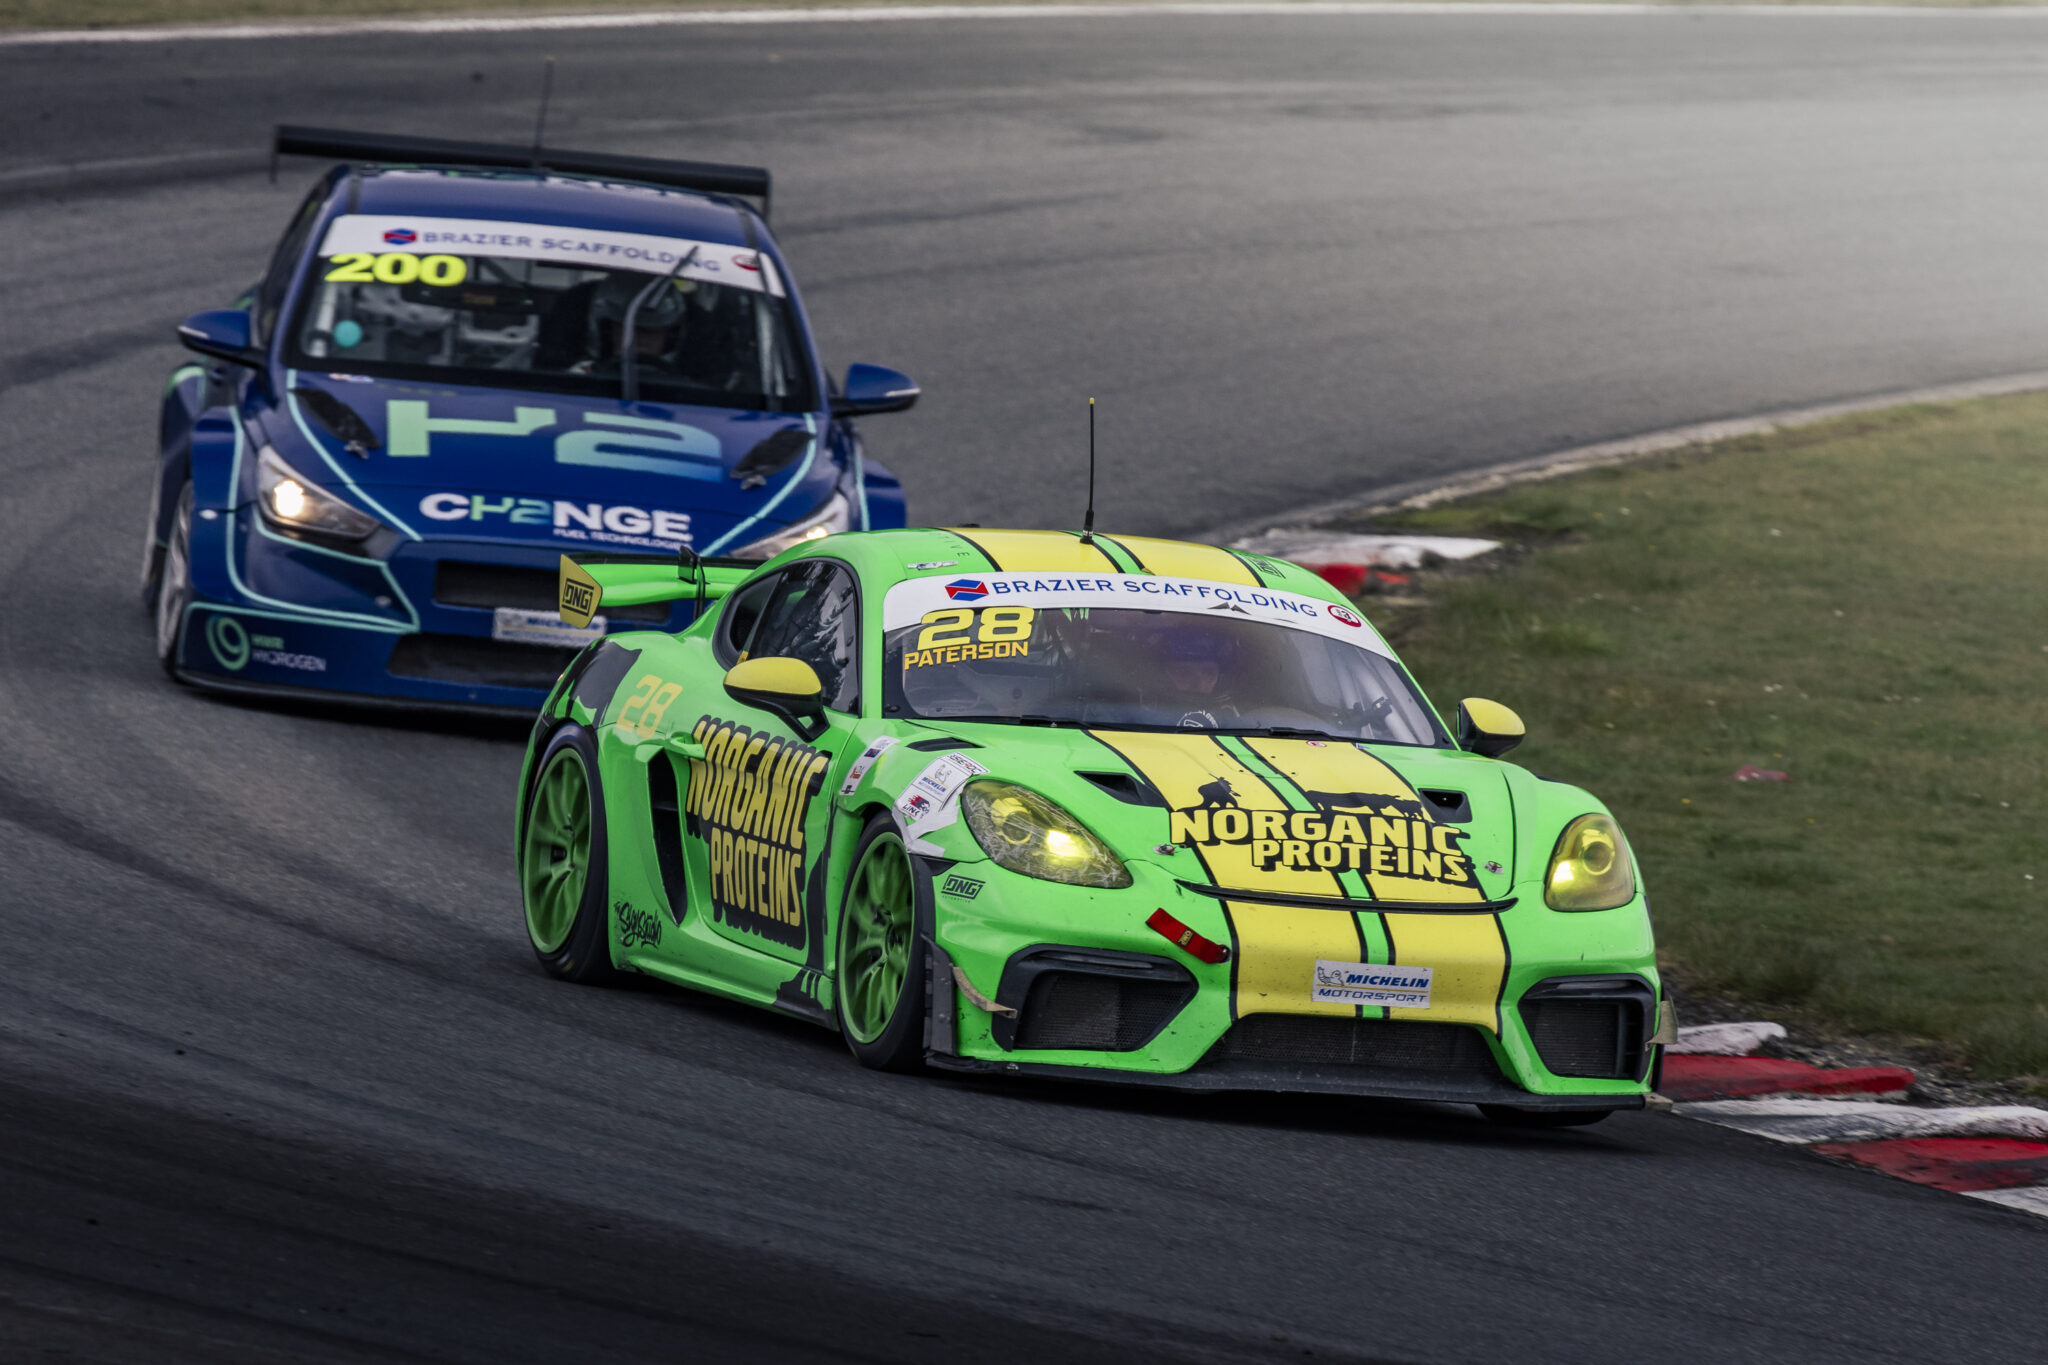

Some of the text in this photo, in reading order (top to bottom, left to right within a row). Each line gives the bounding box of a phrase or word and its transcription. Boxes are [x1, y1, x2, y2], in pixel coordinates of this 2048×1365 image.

[423, 231, 532, 249] BRAZIER
[324, 252, 468, 287] 200
[991, 579, 1116, 595] BRAZIER
[1123, 579, 1319, 618] SCAFFOLDING
[917, 606, 1035, 651] 28
[904, 641, 1029, 671] PATERSON
[615, 674, 684, 740] 28
[686, 719, 830, 850] NORGANIC
[1170, 808, 1463, 856] NORGANIC
[710, 826, 802, 928] PROTEINS
[1252, 839, 1470, 883] PROTEINS
[1318, 988, 1428, 1003] MOTORSPORT
[1345, 973, 1430, 989] MICHELIN
